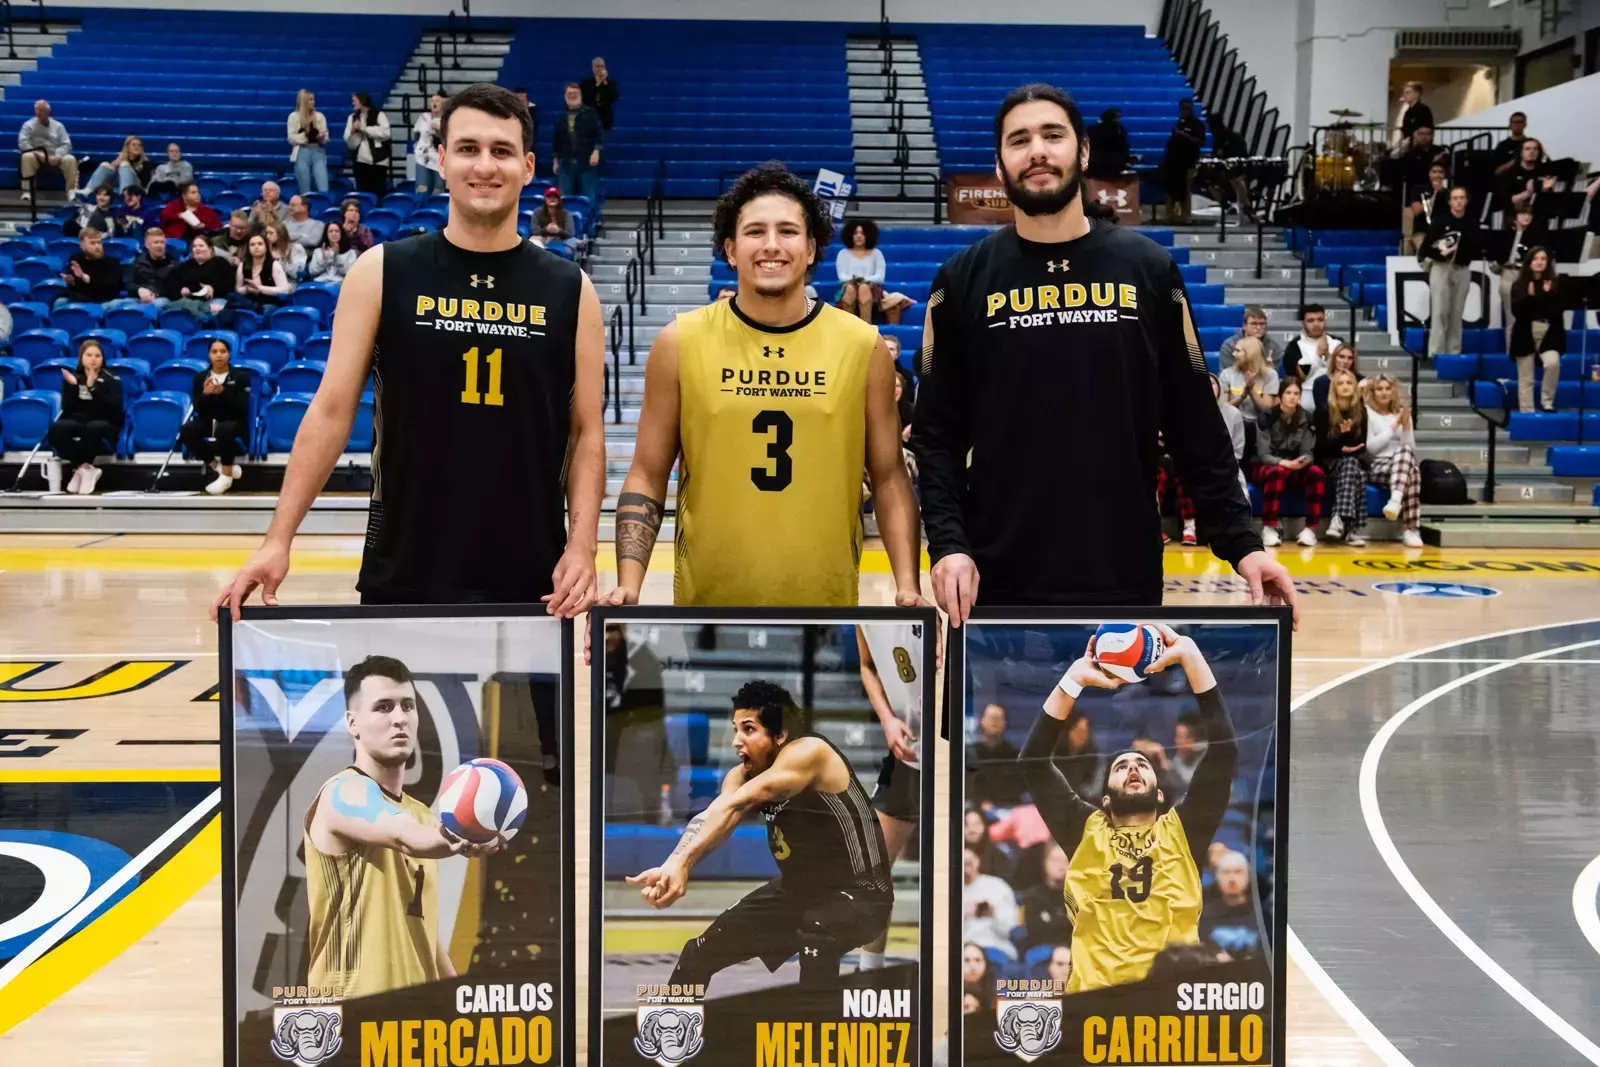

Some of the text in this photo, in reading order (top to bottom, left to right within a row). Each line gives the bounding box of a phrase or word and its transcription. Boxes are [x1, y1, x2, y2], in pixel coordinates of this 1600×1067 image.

[958, 189, 1008, 203] FIREH
[416, 295, 546, 326] PURDUE
[986, 282, 1138, 317] PURDUE
[434, 319, 527, 337] FORT WAYNE
[1009, 309, 1118, 329] FORT WAYNE
[461, 346, 504, 406] 11
[721, 368, 826, 386] PURDUE
[735, 387, 811, 397] FORT WAYNE
[750, 410, 793, 492] 3
[892, 647, 917, 683] 8
[405, 862, 425, 919] 1
[1109, 856, 1153, 903] 19
[273, 986, 343, 998] PURDUE
[456, 983, 553, 1014] CARLOS
[637, 984, 705, 996] PURDUE
[997, 979, 1064, 991] PURDUE
[1177, 982, 1264, 1011] SERGIO
[843, 989, 911, 1018] NOAH
[361, 1015, 552, 1067] MERCADO
[756, 1022, 911, 1067] MELENDEZ
[1083, 1014, 1263, 1063] CARRILLO
